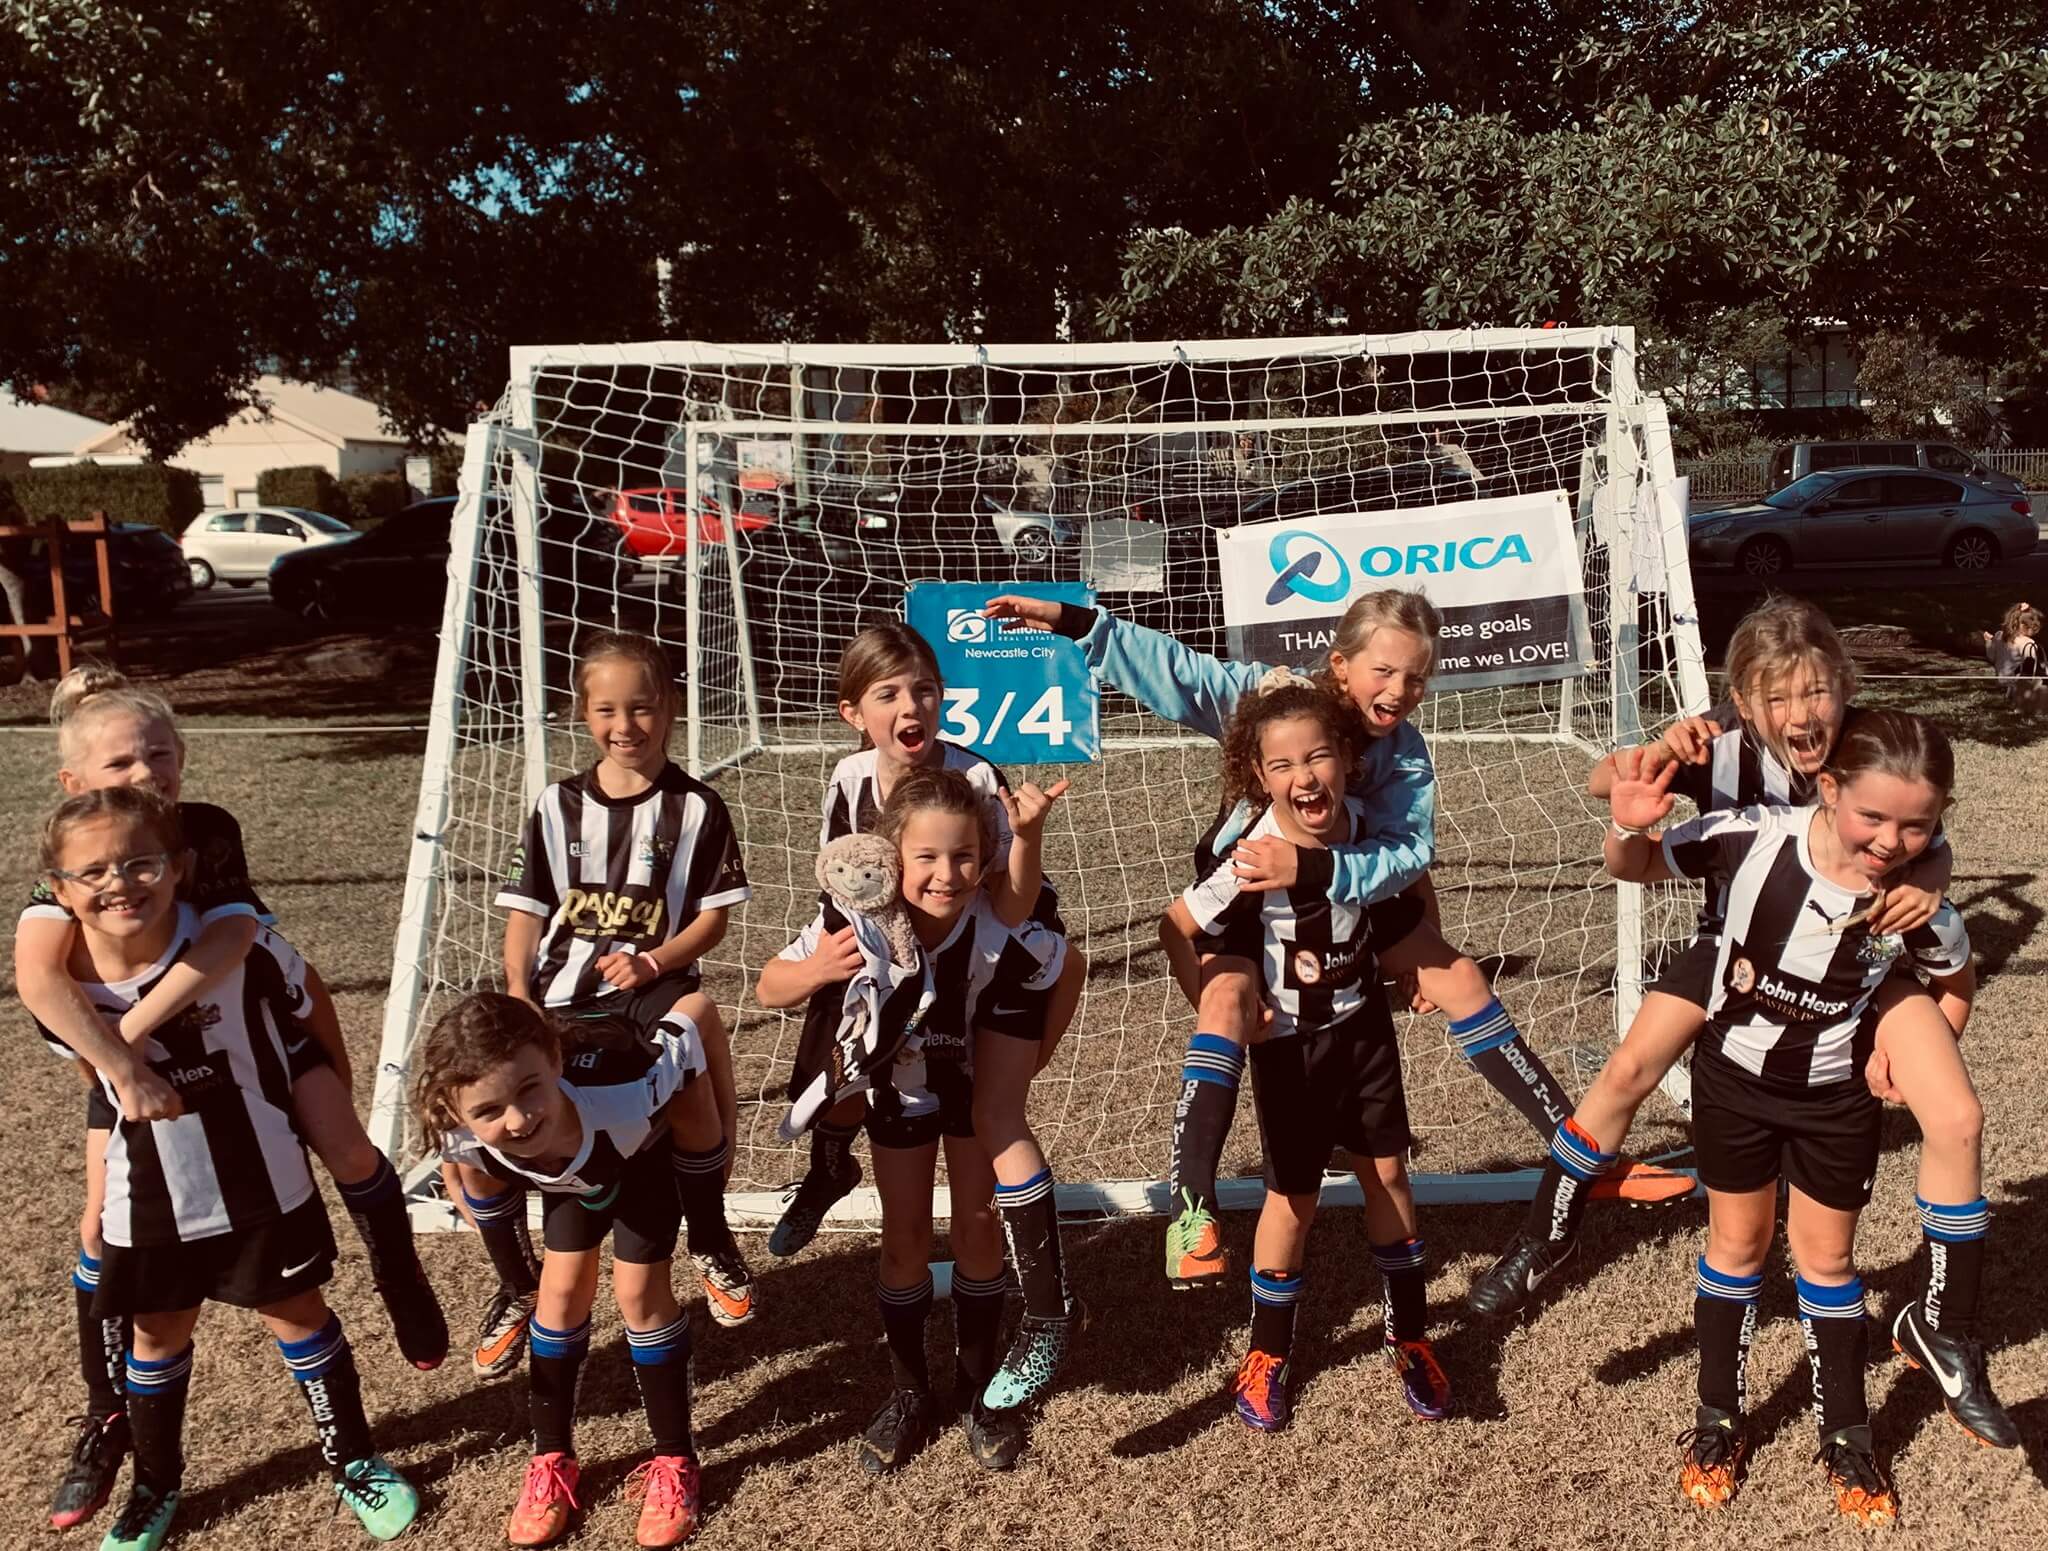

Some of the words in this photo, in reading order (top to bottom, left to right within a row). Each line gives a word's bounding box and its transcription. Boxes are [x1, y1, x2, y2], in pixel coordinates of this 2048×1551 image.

[1359, 533, 1533, 577] ORICA
[1479, 613, 1532, 639] goals
[965, 648, 1029, 658] Newcastle
[1031, 647, 1056, 659] City
[1475, 653, 1504, 667] we
[1509, 641, 1570, 663] LOVE!
[935, 686, 1073, 747] 3/4
[1324, 951, 1354, 970] John
[1757, 974, 1797, 1003] John
